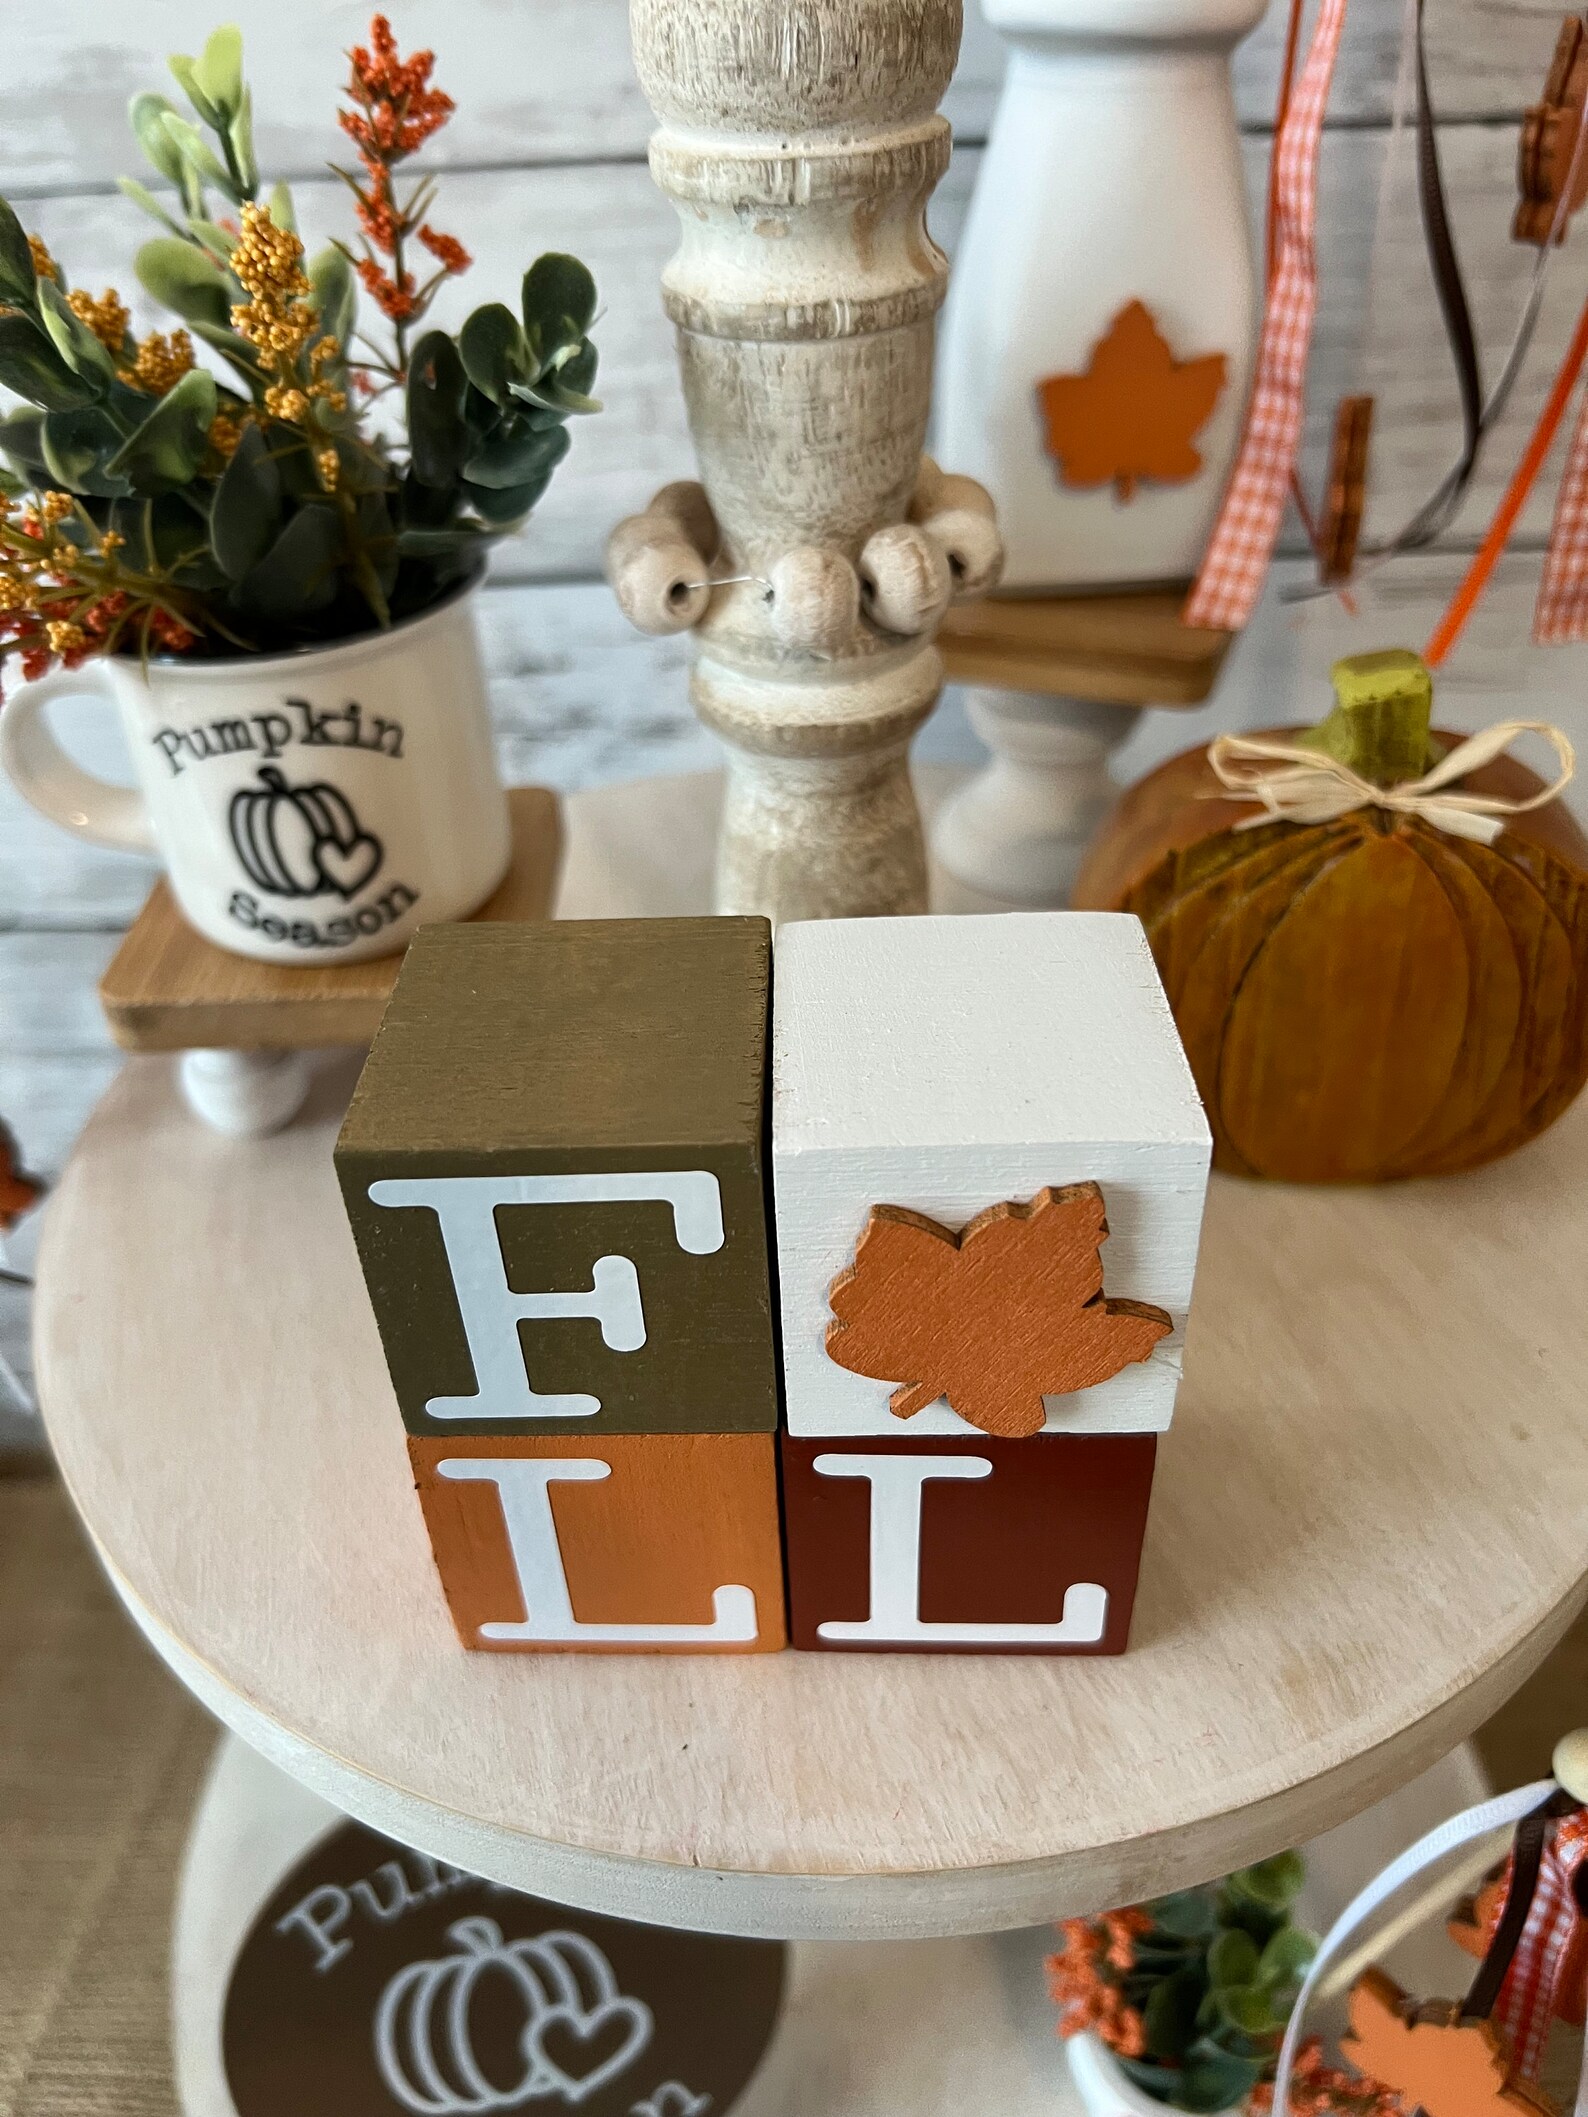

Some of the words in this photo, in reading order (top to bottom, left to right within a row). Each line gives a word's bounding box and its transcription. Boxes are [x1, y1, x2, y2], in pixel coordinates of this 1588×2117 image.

[153, 697, 405, 775] Pumpkin
[229, 883, 419, 948] Season
[368, 1170, 725, 1419] F
